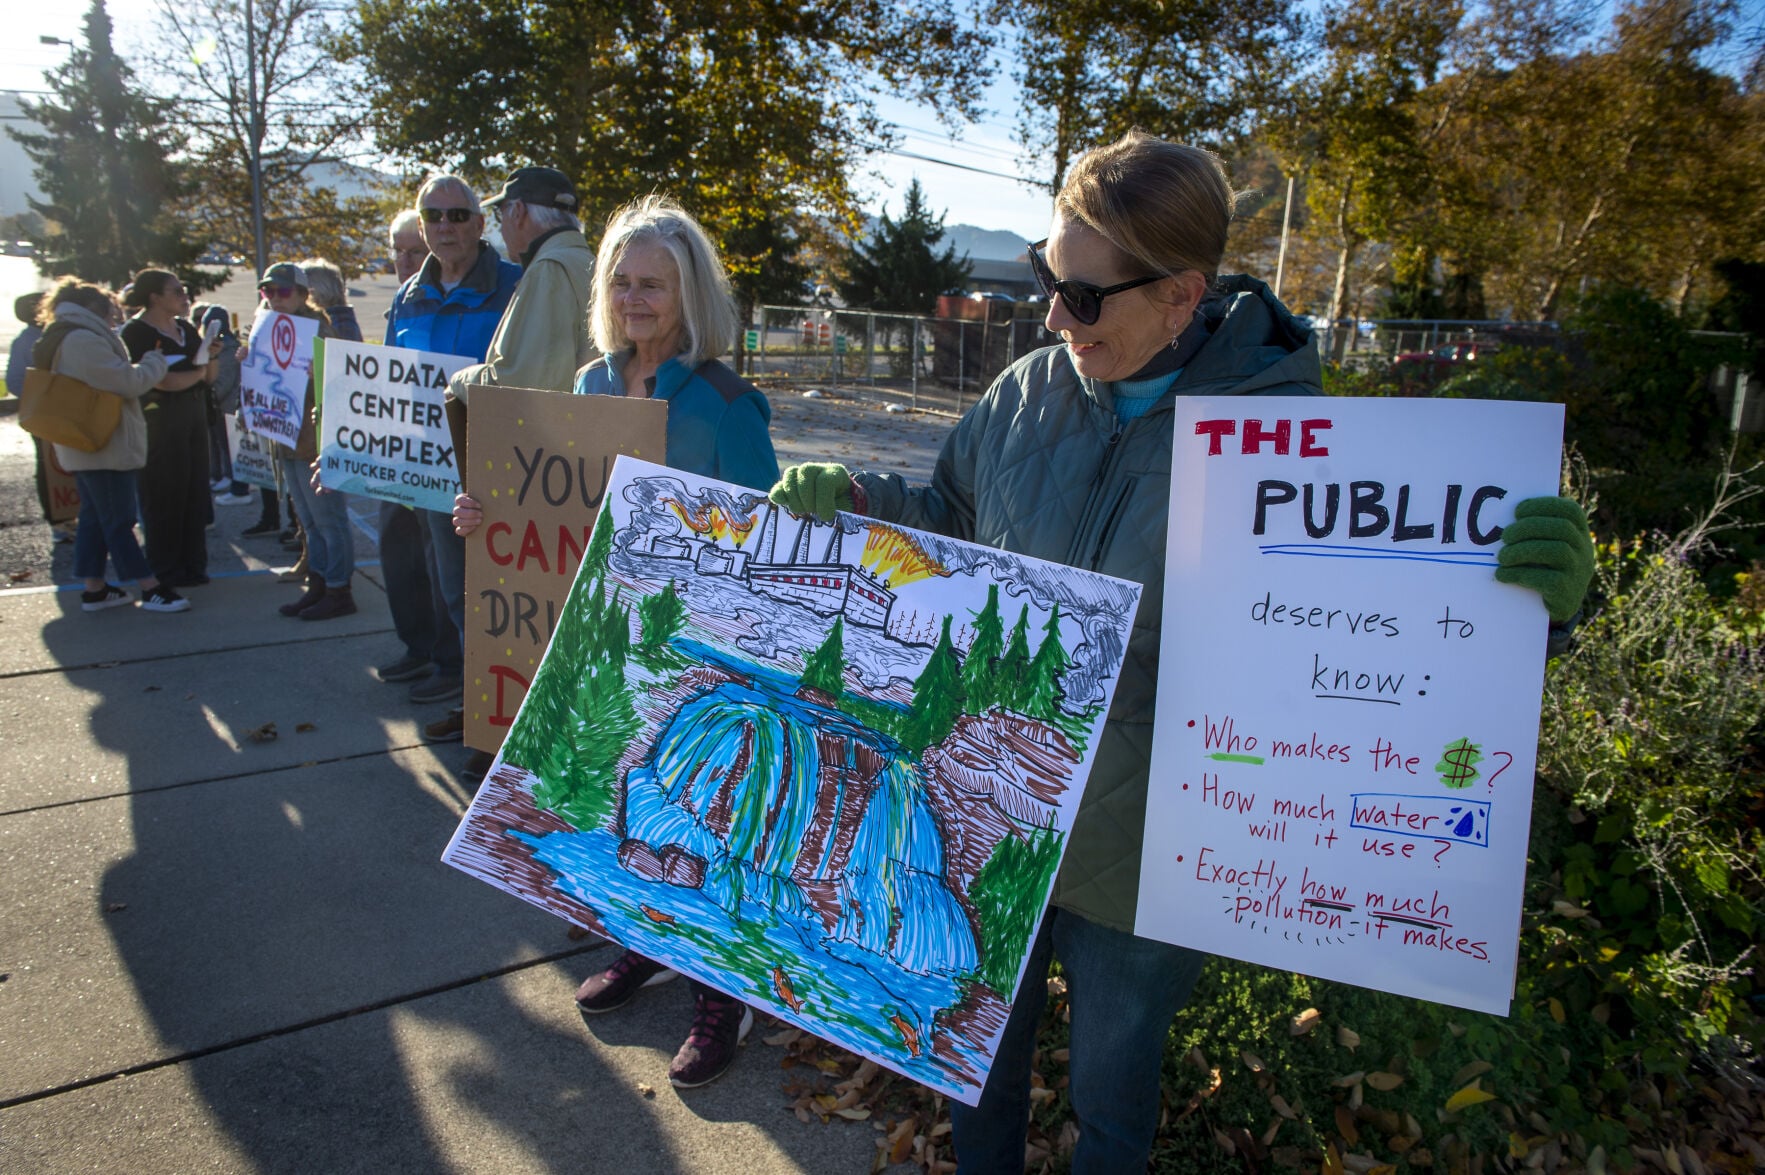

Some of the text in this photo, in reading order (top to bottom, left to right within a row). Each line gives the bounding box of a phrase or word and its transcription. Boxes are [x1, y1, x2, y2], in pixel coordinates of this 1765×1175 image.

[276, 325, 292, 353] NO
[345, 353, 448, 389] NO DATA
[242, 386, 288, 413] WE ALL LIVE
[349, 391, 443, 429] CENTER
[336, 426, 454, 469] COMPLEX
[1194, 418, 1334, 459] THE
[236, 453, 273, 471] COMPL
[327, 456, 461, 493] IN TUCKER COUNTY
[513, 446, 609, 509] YOU
[1252, 480, 1508, 546] PUBLIC
[480, 589, 556, 646] DRI
[1251, 592, 1474, 639] deserves to
[1205, 715, 1258, 752] Who
[1272, 733, 1351, 763] makes
[1369, 737, 1420, 775] the
[1203, 773, 1440, 830] How much water
[1248, 821, 1286, 843] will
[1315, 828, 1339, 848] it
[1196, 847, 1450, 919] Exactly how much
[1366, 918, 1389, 939] it
[1403, 928, 1491, 963] makes.
